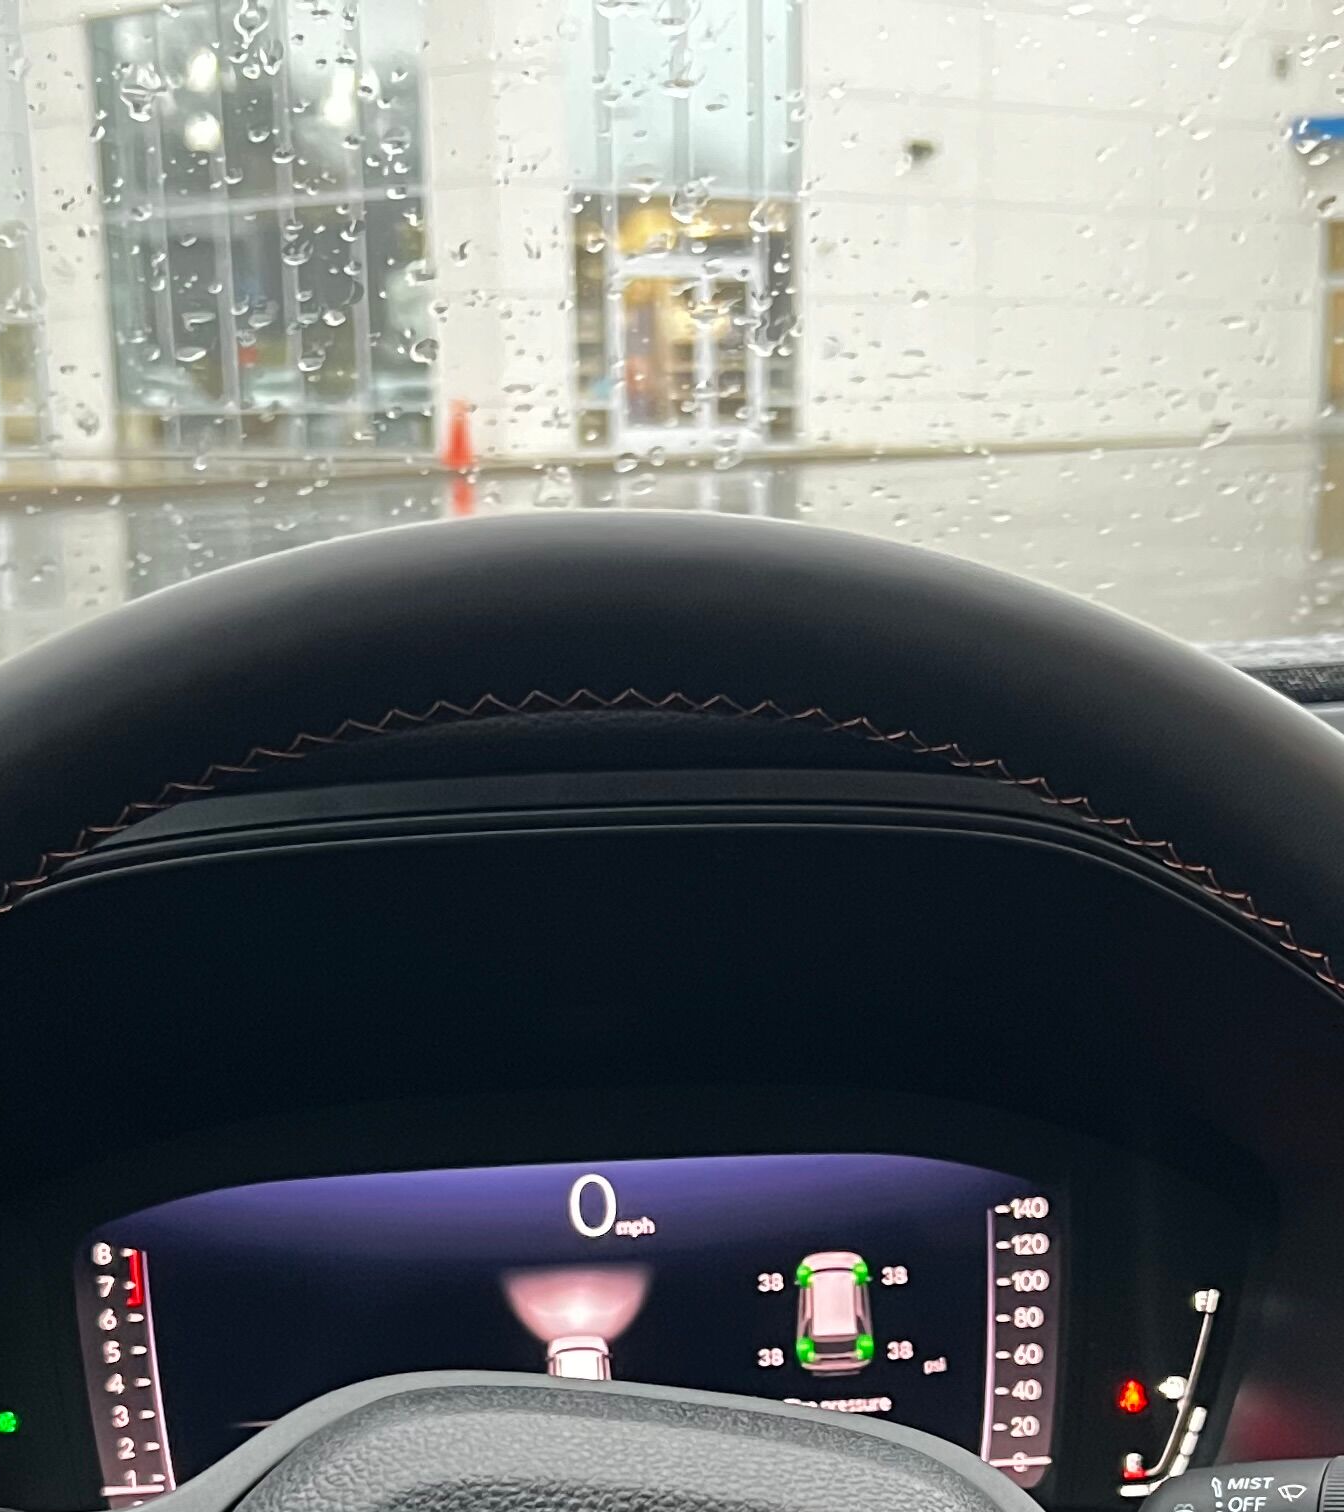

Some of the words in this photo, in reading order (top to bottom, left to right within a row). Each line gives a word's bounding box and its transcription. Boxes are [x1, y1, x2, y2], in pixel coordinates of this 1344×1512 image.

[569, 1174, 616, 1237] 0
[616, 1217, 655, 1237] mph
[1010, 1196, 1049, 1219] 140
[92, 1242, 112, 1266] 8
[1011, 1232, 1050, 1256] 120
[97, 1276, 115, 1297] 7
[757, 1272, 785, 1292] 38
[880, 1265, 908, 1286] 38
[1011, 1269, 1050, 1292] 100
[98, 1308, 118, 1331] 6
[1013, 1306, 1045, 1329] 80
[102, 1340, 122, 1364] 5
[757, 1347, 785, 1367] 38
[886, 1340, 914, 1360] 38
[1013, 1342, 1045, 1366] 60
[106, 1374, 125, 1394] 4
[1011, 1378, 1042, 1401] 40
[111, 1404, 130, 1428] 3
[1010, 1415, 1041, 1438] 20
[118, 1438, 135, 1459] 2
[124, 1470, 136, 1488] 1
[1227, 1477, 1275, 1490] MIST
[1228, 1496, 1267, 1512] OFF
